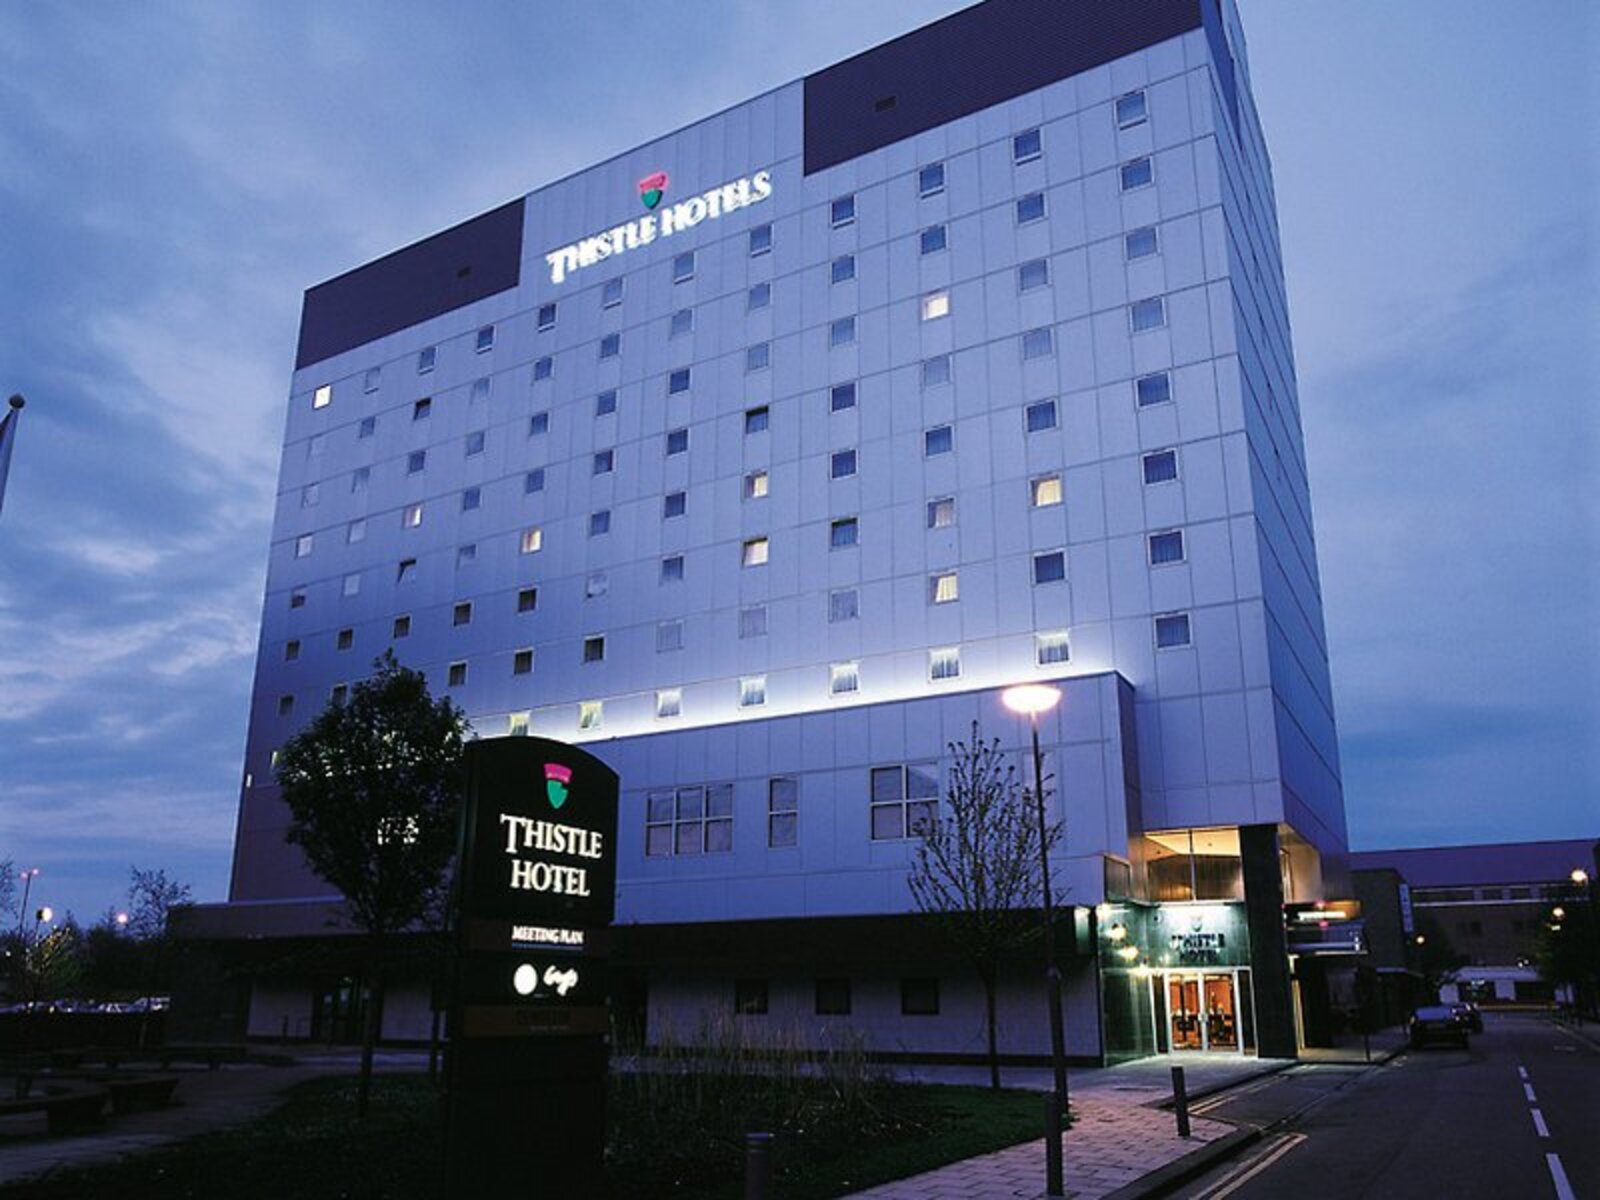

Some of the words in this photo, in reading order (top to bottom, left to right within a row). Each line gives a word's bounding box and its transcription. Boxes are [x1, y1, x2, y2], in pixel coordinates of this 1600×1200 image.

[546, 215, 657, 284] THISTLE
[661, 171, 772, 237] HOTELS
[500, 813, 603, 860] THISTLE
[510, 859, 590, 897] HOTEL
